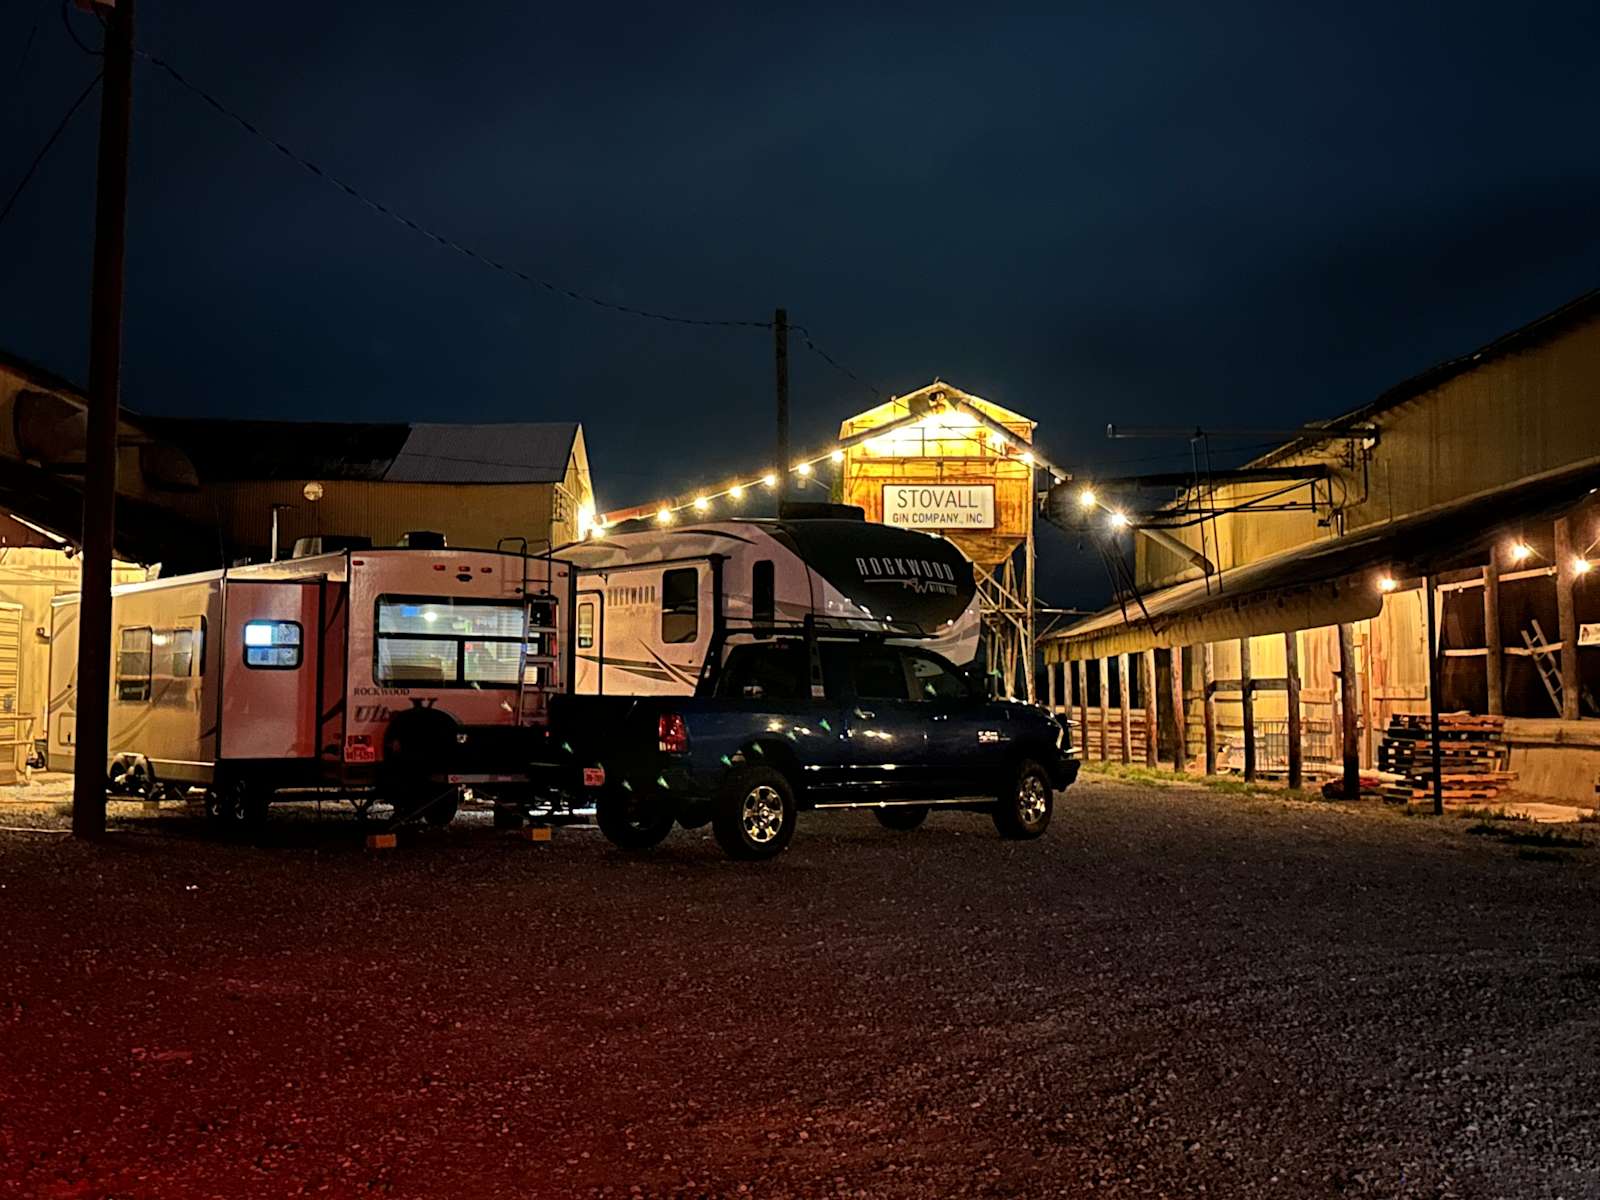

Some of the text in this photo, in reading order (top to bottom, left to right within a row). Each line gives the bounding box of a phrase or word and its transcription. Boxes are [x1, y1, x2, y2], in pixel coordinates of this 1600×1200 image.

[897, 489, 979, 508] STOVALL
[892, 513, 909, 524] GIN
[966, 513, 985, 524] INC.
[856, 557, 954, 581] ROCKWOOD
[353, 687, 410, 697] ROCKWOOD
